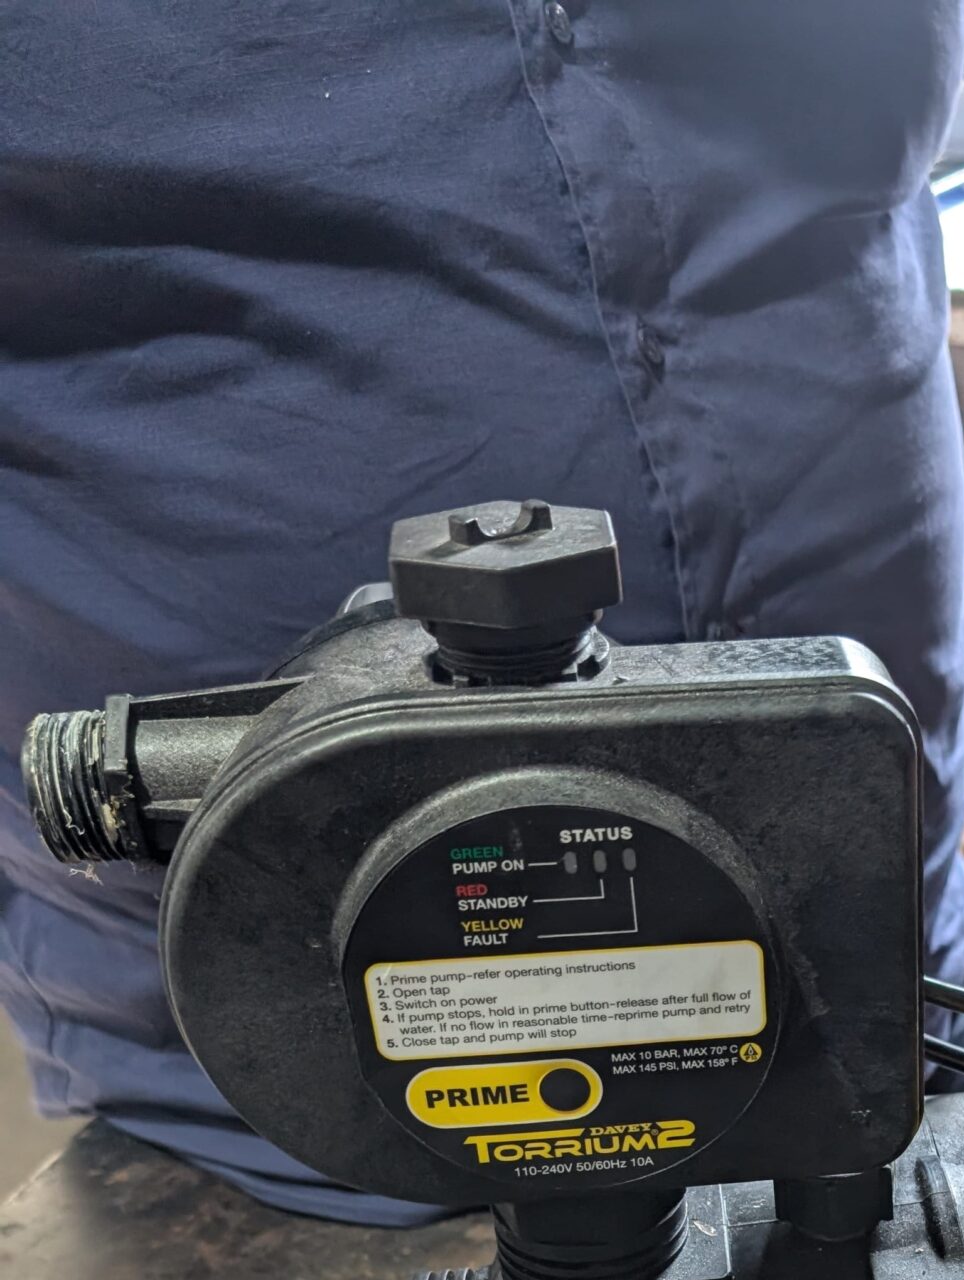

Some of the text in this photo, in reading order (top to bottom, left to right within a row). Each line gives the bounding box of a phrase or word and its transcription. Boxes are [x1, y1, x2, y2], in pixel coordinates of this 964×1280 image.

[559, 826, 633, 843] STATUS
[450, 847, 504, 860] GREEN
[452, 859, 525, 875] PUMP ON
[455, 884, 488, 897] RED
[458, 896, 528, 911] STANDBY
[461, 918, 524, 932] YELLOW
[463, 933, 509, 947] FAULT
[376, 961, 636, 986] 1. Prime pump-refer operating instructions
[377, 986, 450, 1000] 2. Open tap
[379, 996, 498, 1011] 3. Switch on power
[382, 989, 751, 1024] 4. If pump stops, hold in prime button-release after full flow of
[399, 1003, 751, 1035] water. If no flow in reasonable time-reprime pump and retry
[387, 1027, 577, 1048] 5. Close tap and pump will stop
[611, 1052, 636, 1063] MAX
[639, 1051, 652, 1060] 10
[654, 1049, 680, 1059] BAR,
[683, 1047, 708, 1057] MAX
[729, 1044, 739, 1054] C
[612, 1064, 637, 1075] MAX
[639, 1063, 657, 1072] 145
[659, 1061, 679, 1072] PSI,
[681, 1059, 706, 1070] MAX
[731, 1057, 739, 1066] F
[425, 1083, 530, 1109] PRIME
[590, 1122, 652, 1137] DAVEY
[514, 1156, 655, 1177] 110-240V 50/60Hz 10A
